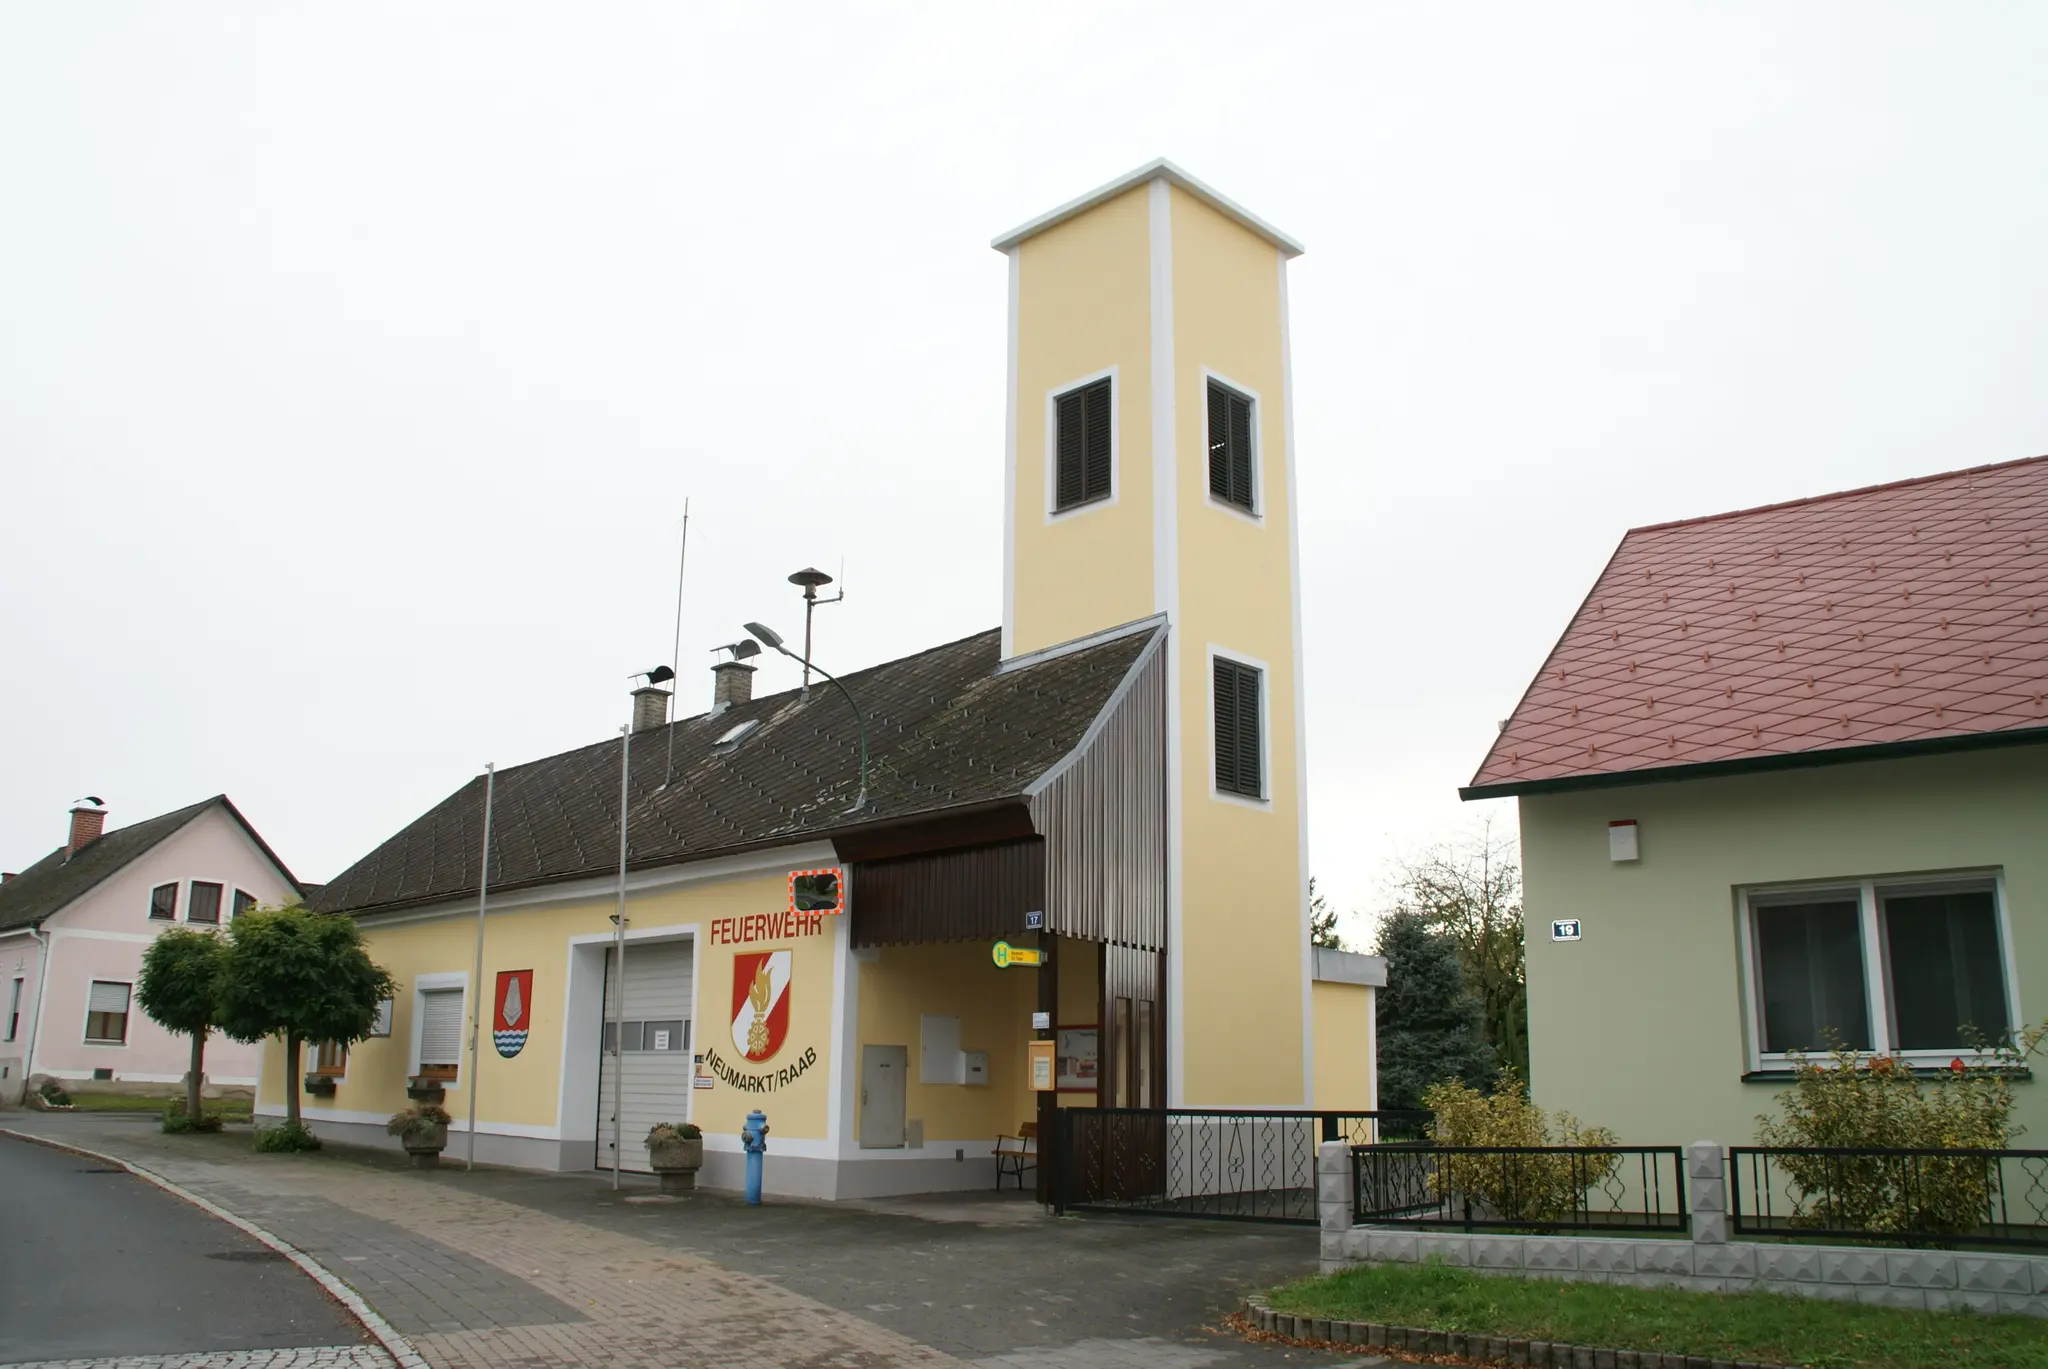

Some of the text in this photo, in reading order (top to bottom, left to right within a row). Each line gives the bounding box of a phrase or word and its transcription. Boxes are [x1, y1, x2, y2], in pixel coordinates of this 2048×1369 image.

[710, 911, 822, 946] FEUERWEHR
[1030, 916, 1039, 925] 17
[1559, 925, 1574, 936] 19
[997, 946, 1007, 963] H
[705, 1046, 817, 1093] NEUMARKT/RAAB
